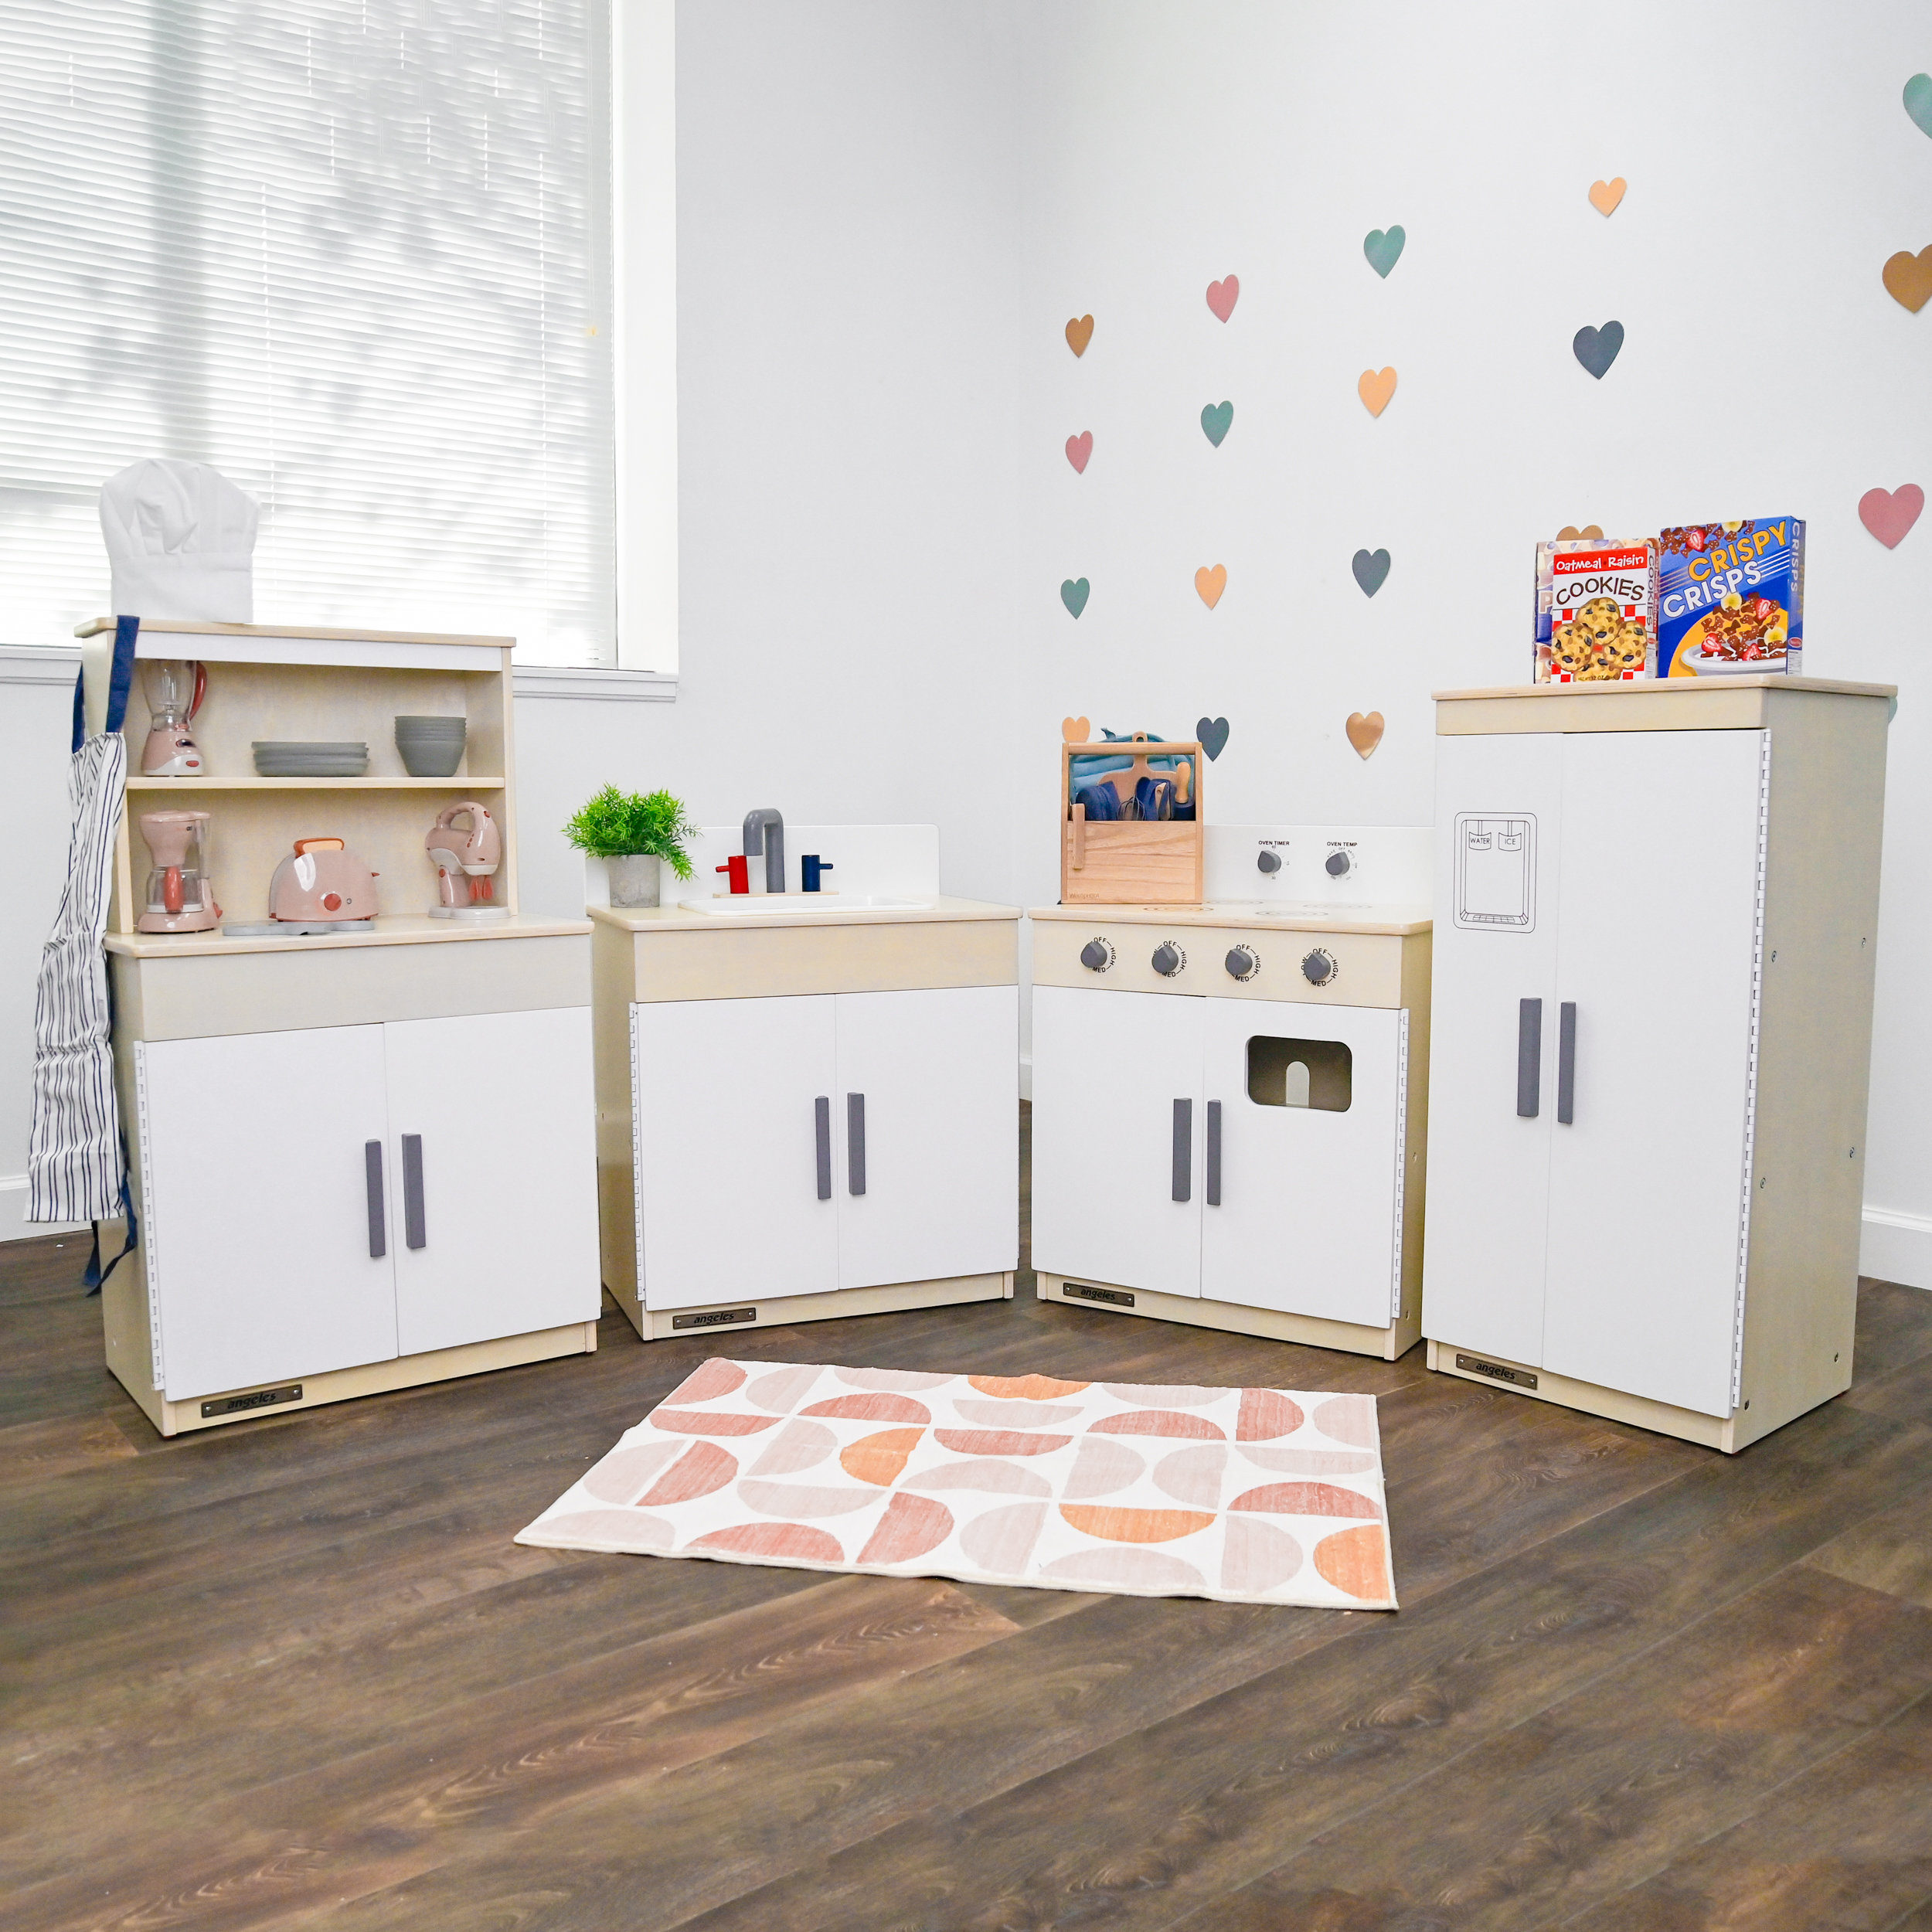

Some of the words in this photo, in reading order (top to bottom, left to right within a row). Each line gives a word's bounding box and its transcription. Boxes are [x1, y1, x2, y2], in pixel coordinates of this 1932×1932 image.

[1688, 521, 1787, 581] CRISPY
[1791, 522, 1801, 592] CRISPS
[1556, 558, 1602, 571] Oatmeal
[1608, 554, 1645, 568] Raisin
[1556, 577, 1645, 605] COOKIES
[1662, 560, 1761, 617] CRISPS
[1080, 1288, 1115, 1300] angeles
[693, 1312, 734, 1324] angeles
[1476, 1363, 1515, 1379] angeles
[227, 1393, 277, 1409] angeles
